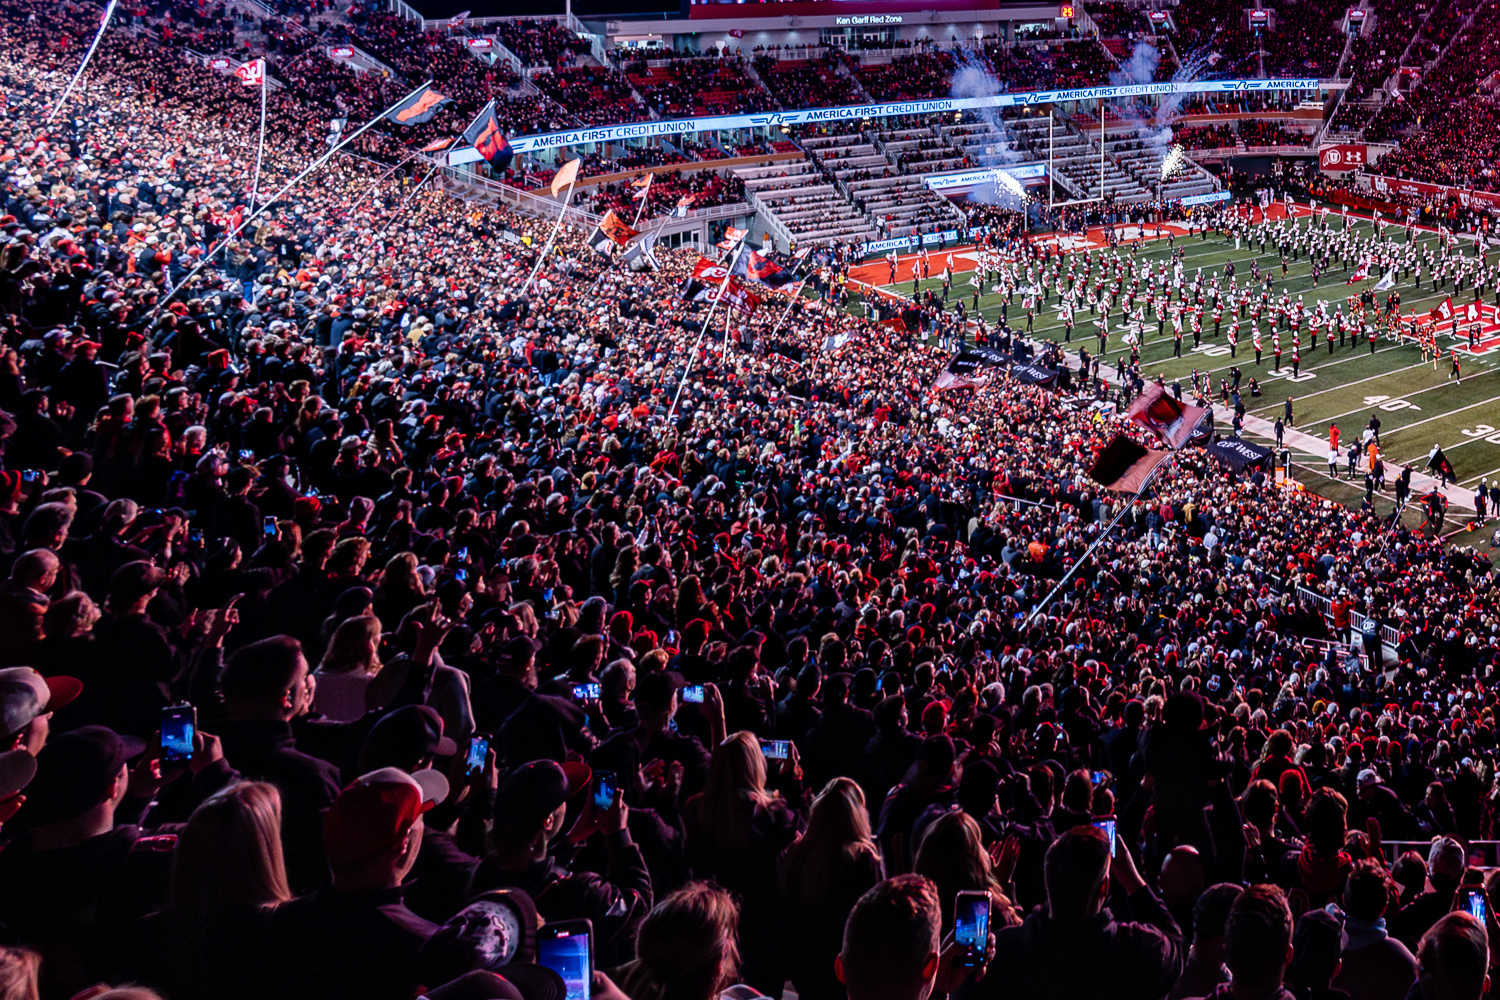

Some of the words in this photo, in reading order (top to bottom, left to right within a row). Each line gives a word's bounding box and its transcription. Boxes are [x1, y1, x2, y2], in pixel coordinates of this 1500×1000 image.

[1062, 6, 1073, 17] 25
[836, 16, 850, 24] Ken
[870, 15, 884, 23] Red
[885, 15, 902, 23] Zone
[1266, 80, 1305, 89] AMERICA
[1056, 89, 1093, 100] AMERICA
[1094, 87, 1118, 97] FIRST
[1120, 85, 1150, 95] CREDIT
[806, 110, 853, 121] AMERICA
[854, 106, 885, 118] FIRST
[886, 102, 921, 114] CREDIT
[922, 100, 952, 111] UNION
[532, 133, 580, 148] AMERICA
[582, 129, 613, 142] FIRST
[616, 124, 656, 136] CREDIT
[658, 120, 696, 132] UNION
[960, 175, 985, 183] AMERICA
[869, 239, 903, 251] AMERICA
[1363, 395, 1411, 411] 40
[1236, 444, 1262, 460] WEST
